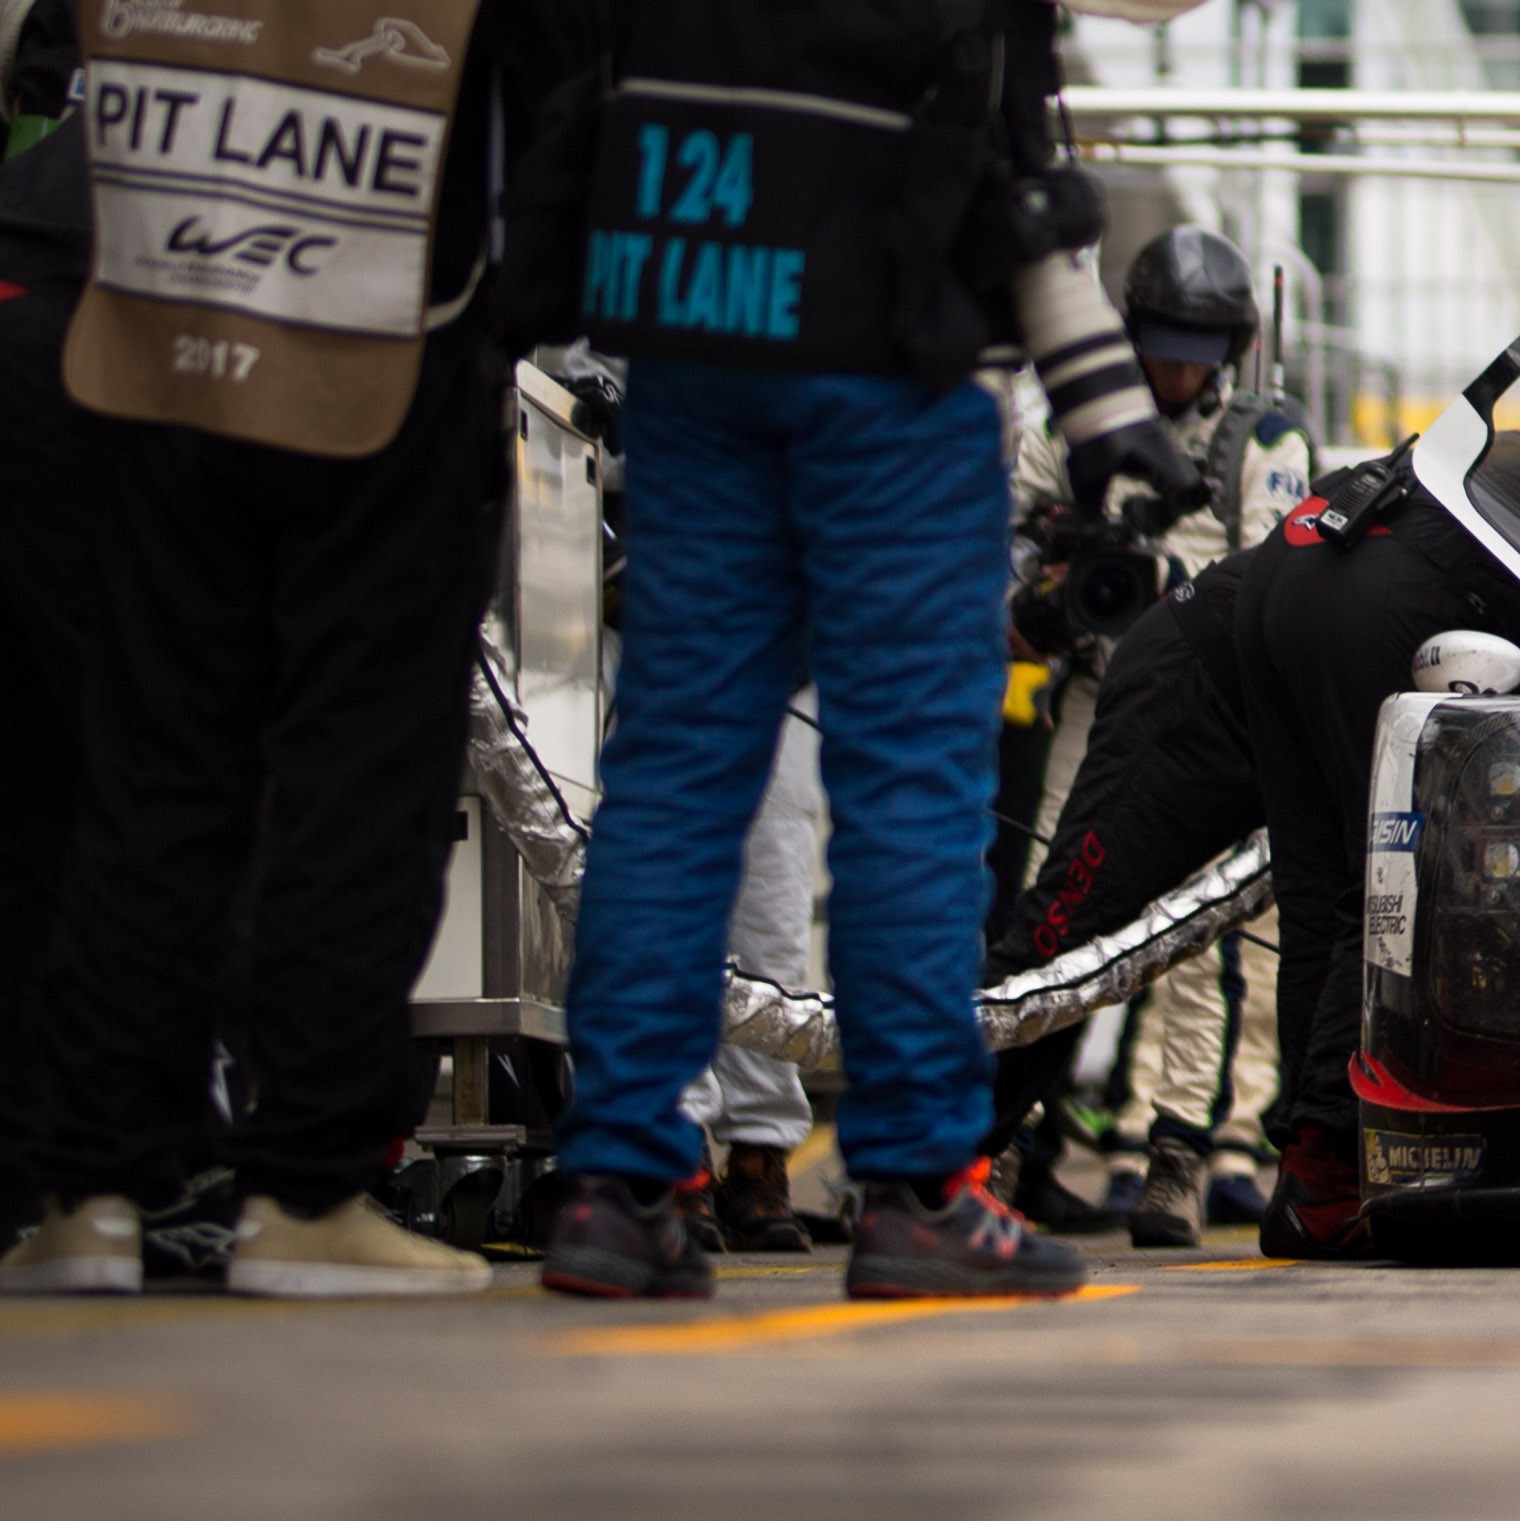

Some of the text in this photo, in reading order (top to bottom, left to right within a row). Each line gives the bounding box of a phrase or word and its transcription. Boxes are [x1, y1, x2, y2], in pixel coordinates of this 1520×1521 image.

[96, 82, 429, 197] PIT LANE
[166, 214, 340, 278] WEC
[582, 228, 807, 343] PIT LANE
[174, 335, 262, 382] 2017
[1033, 830, 1107, 958] DENSO
[1388, 1144, 1483, 1170] MICHELIN
